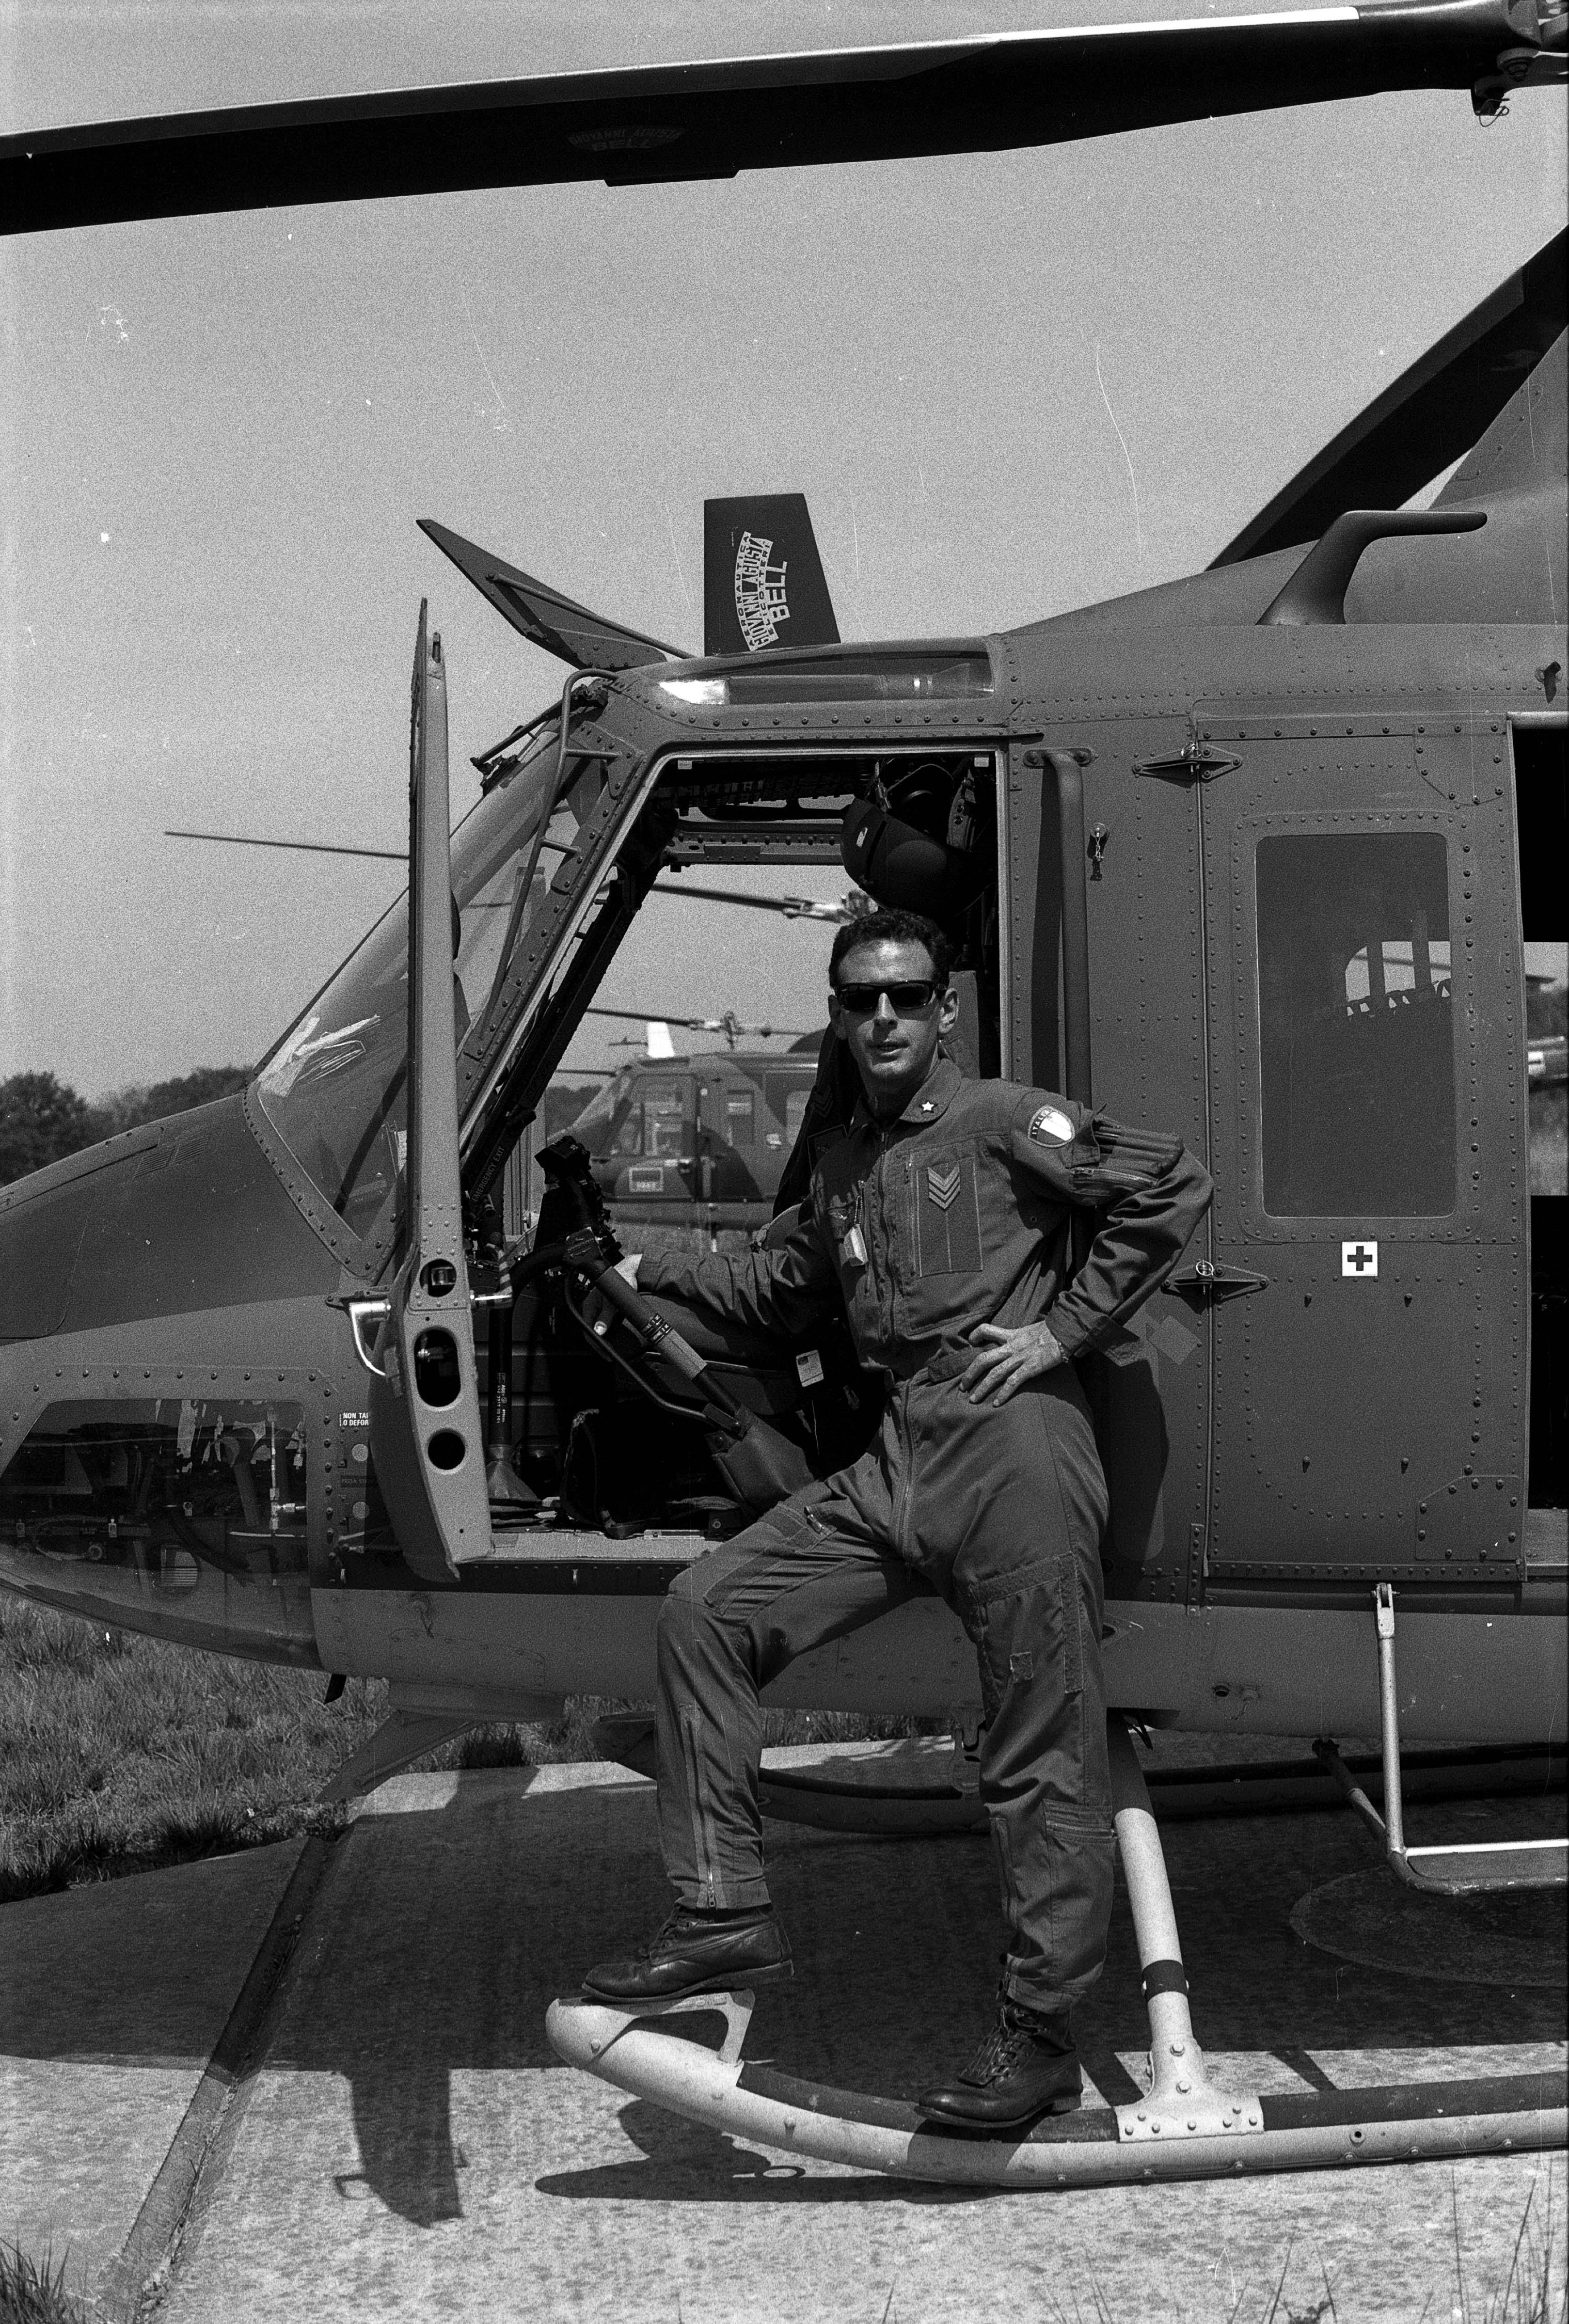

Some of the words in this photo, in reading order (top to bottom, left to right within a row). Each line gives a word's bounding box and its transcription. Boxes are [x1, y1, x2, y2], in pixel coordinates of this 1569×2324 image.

[736, 535, 755, 646] AERONAUTICA
[742, 537, 764, 584] AGUSTA
[758, 541, 773, 635] ELICOTTERI
[742, 592, 770, 649] GIOVANNI
[765, 561, 790, 624] BELL
[471, 1163, 496, 1203] EMERGENCY
[493, 1146, 505, 1163] EXIT
